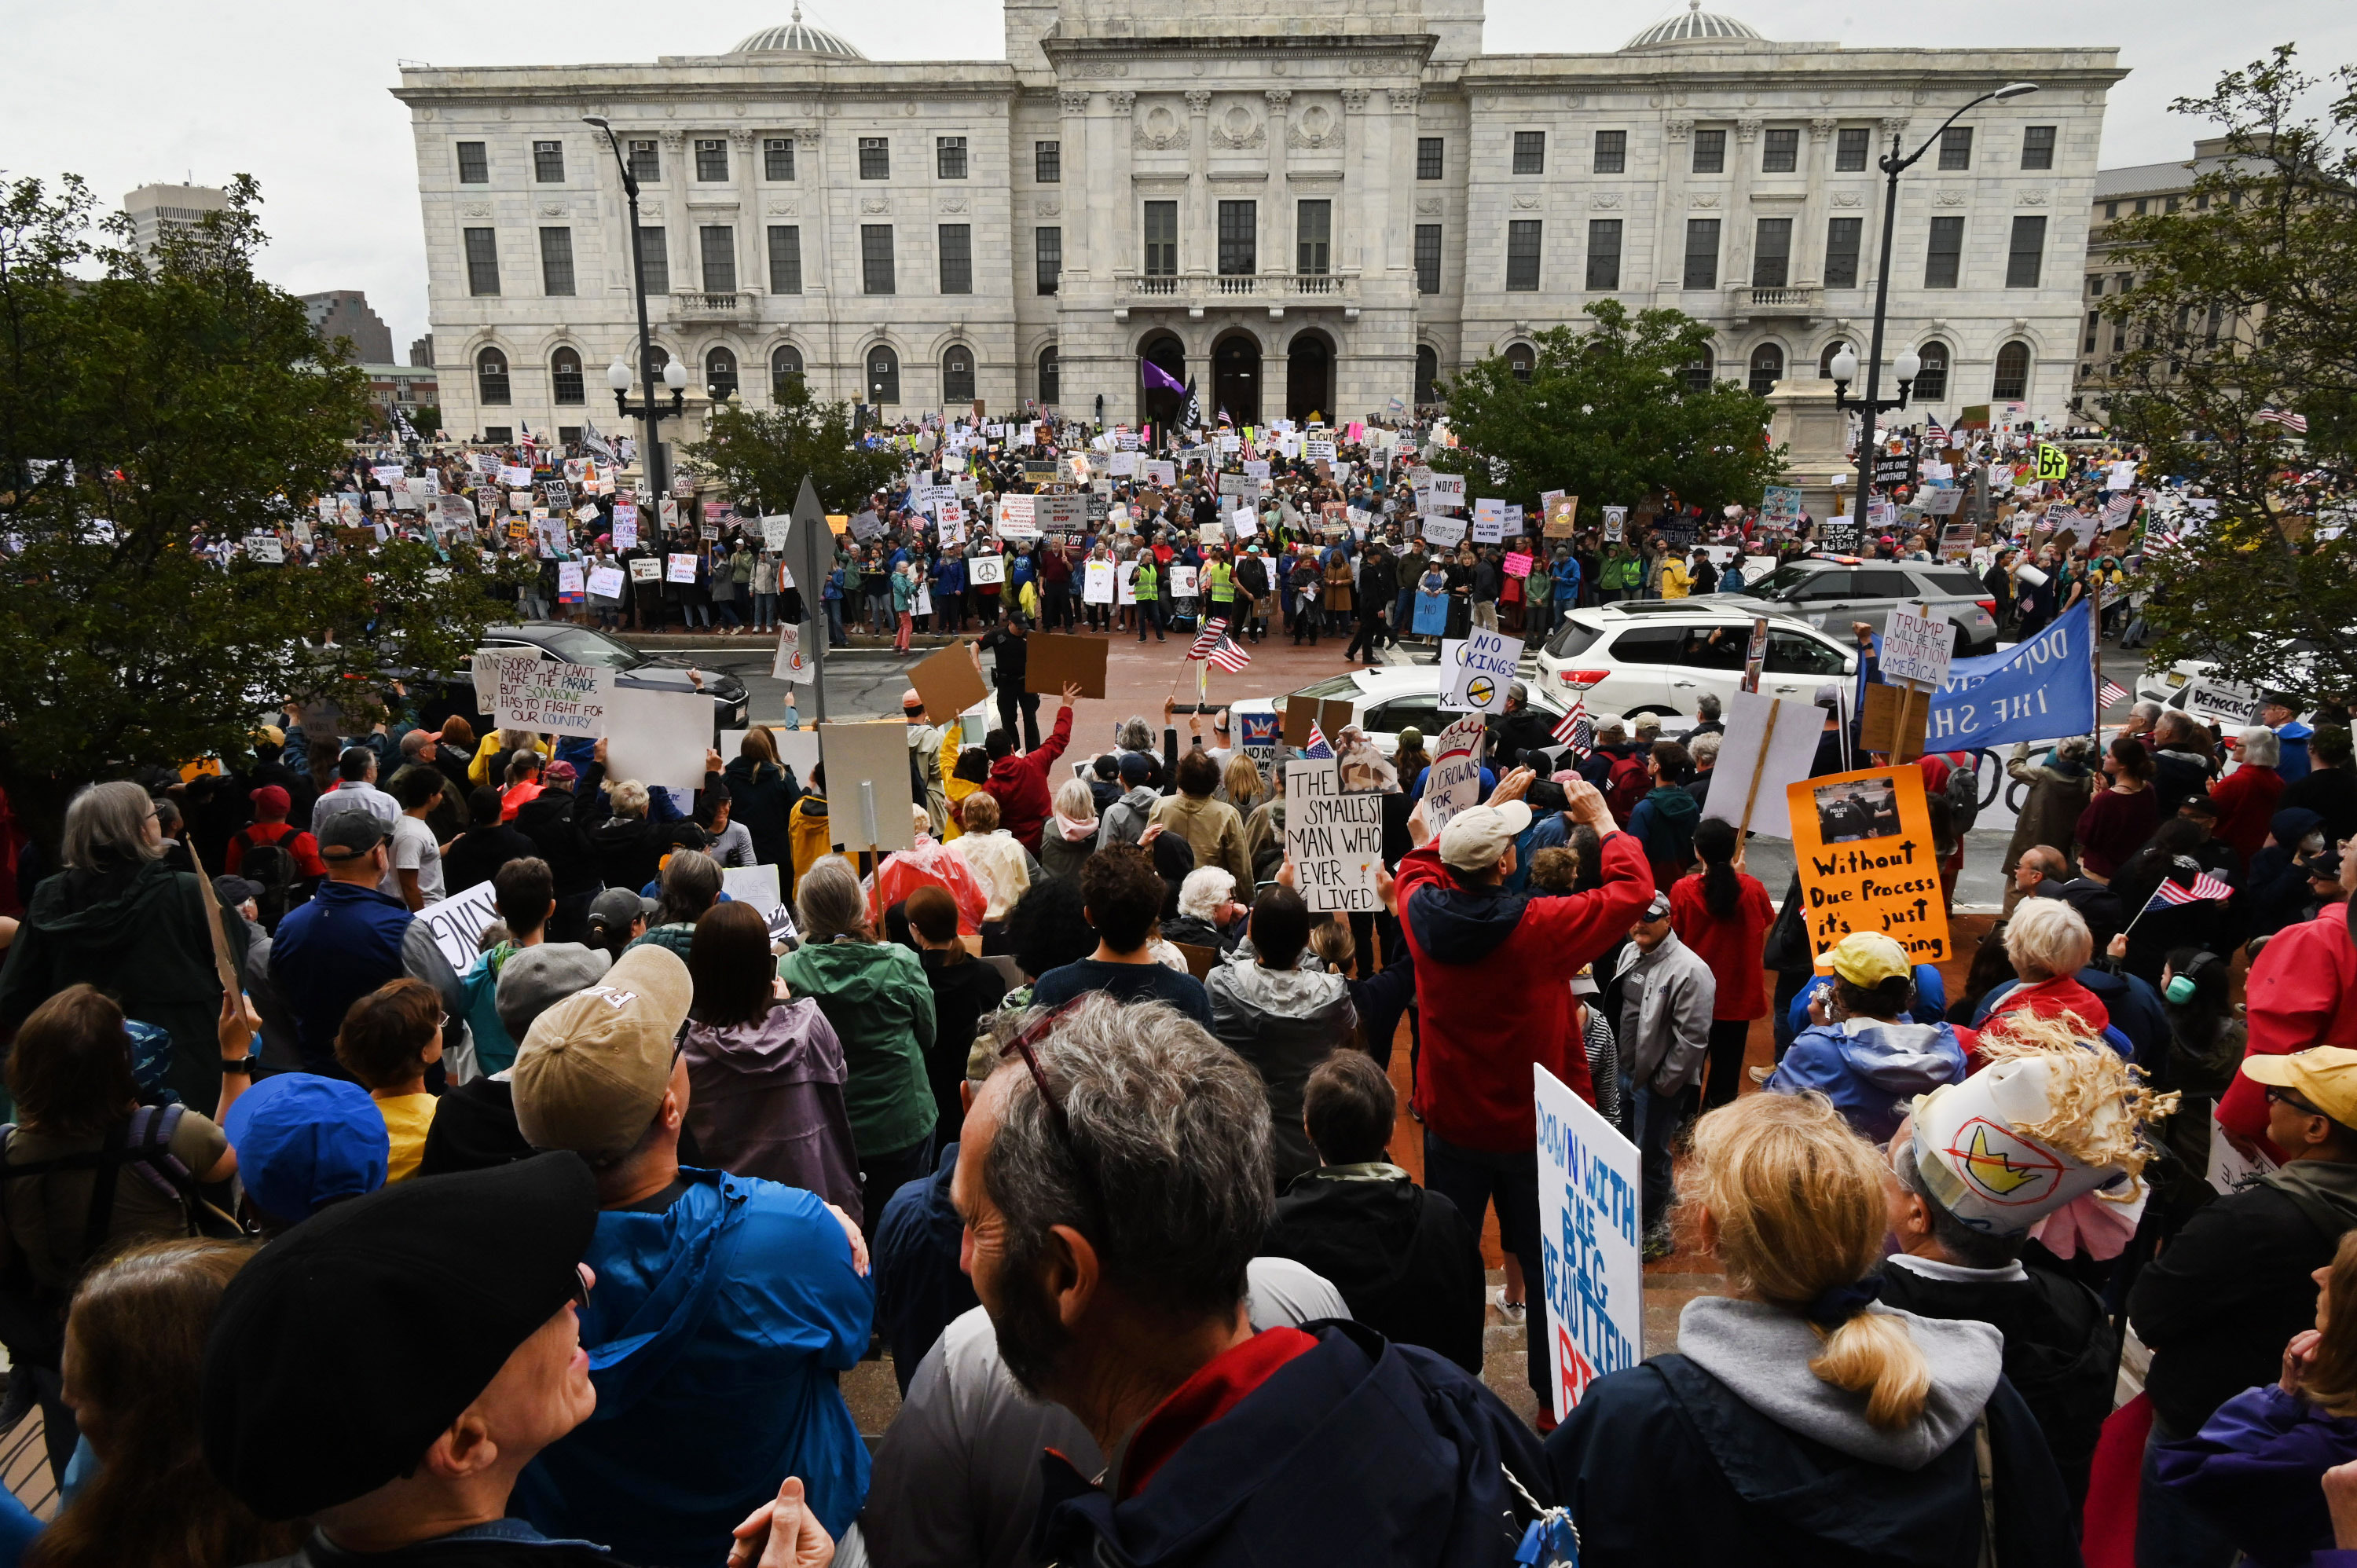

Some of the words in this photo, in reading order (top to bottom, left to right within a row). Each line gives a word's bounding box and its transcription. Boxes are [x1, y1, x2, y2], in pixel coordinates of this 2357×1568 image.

[1189, 449, 1209, 457] DIVERSITY
[1876, 471, 1908, 482] ANOTHER
[1877, 461, 1893, 471] LOVE
[1894, 460, 1909, 469] ONE
[547, 482, 566, 492] NO
[1420, 505, 1430, 515] ICE
[1638, 504, 1661, 513] KINGS
[1069, 535, 1083, 545] OFF
[1423, 523, 1464, 540] MERCY
[1655, 530, 1697, 544] WHITEHOUSE
[1424, 604, 1437, 615] NO
[783, 629, 797, 640] NO
[1895, 613, 1944, 636] TRUMP
[1474, 633, 1501, 653] NO
[1893, 628, 1915, 643] WILL
[1917, 633, 1930, 645] BE
[1930, 636, 1948, 651] THE
[1885, 637, 1948, 665] RUINATION
[502, 656, 540, 672] SORRY
[546, 661, 561, 675] WE
[565, 665, 596, 678] CANT
[1465, 652, 1516, 678] KINGS
[1882, 657, 1937, 681] AMERICA
[500, 683, 522, 694] BUT
[525, 685, 586, 702] SOMEONE
[501, 669, 530, 684] MAKE
[535, 673, 556, 687] THE
[561, 677, 598, 694] PARADE,
[501, 696, 522, 708] HAS
[525, 699, 540, 709] TO
[545, 701, 581, 715] FIGHT
[2194, 689, 2257, 718] DEMOCRACY
[511, 710, 539, 724] OUR
[542, 713, 592, 729] COUNTRY
[1243, 747, 1259, 759] NO
[1438, 758, 1479, 784] CROWNS
[1289, 770, 1336, 797] THE
[1305, 795, 1383, 824] SMALLEST
[1431, 790, 1452, 811] FOR
[1288, 827, 1334, 857] MAN
[1341, 827, 1382, 853] WHO
[1812, 840, 1917, 877] Without
[1300, 860, 1346, 885] EVER
[1318, 888, 1373, 910] LIVED
[1809, 886, 1853, 908] Due
[1862, 877, 1935, 901] Process
[1819, 911, 1851, 936] it's
[1881, 899, 1928, 931] just
[1537, 1099, 1578, 1187] DOWN
[1583, 1144, 1636, 1247] WITH
[1566, 1183, 1596, 1247] THE
[1562, 1207, 1609, 1309] BIG
